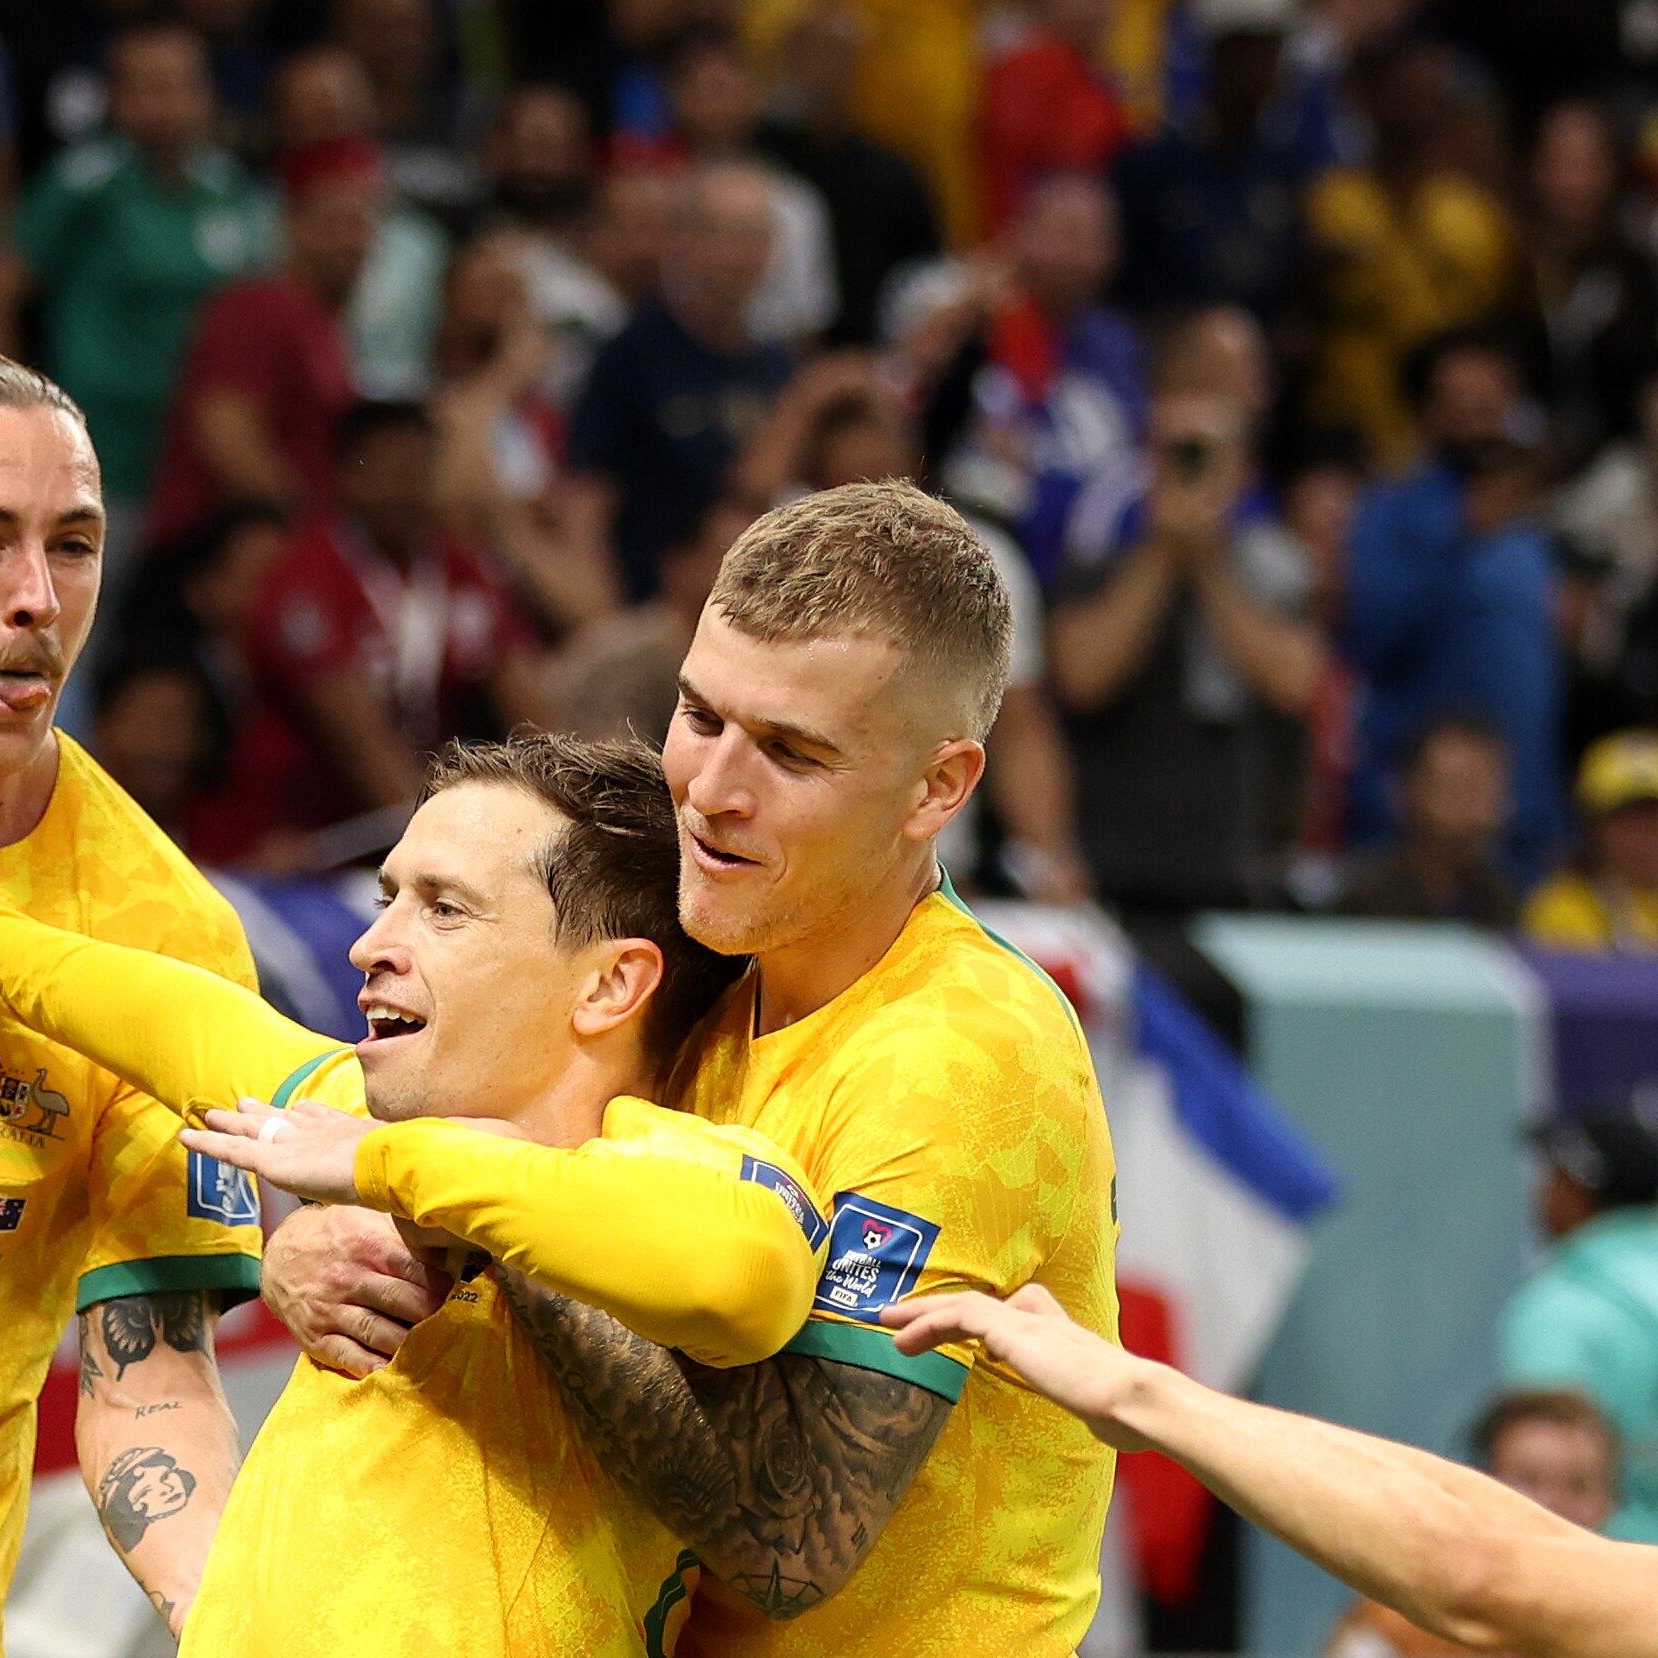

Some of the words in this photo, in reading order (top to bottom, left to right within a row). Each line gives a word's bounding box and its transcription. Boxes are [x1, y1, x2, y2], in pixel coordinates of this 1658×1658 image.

[832, 1258, 879, 1283] UNITES
[825, 1270, 843, 1283] the
[842, 1274, 876, 1298] World
[135, 1401, 183, 1420] REAL
